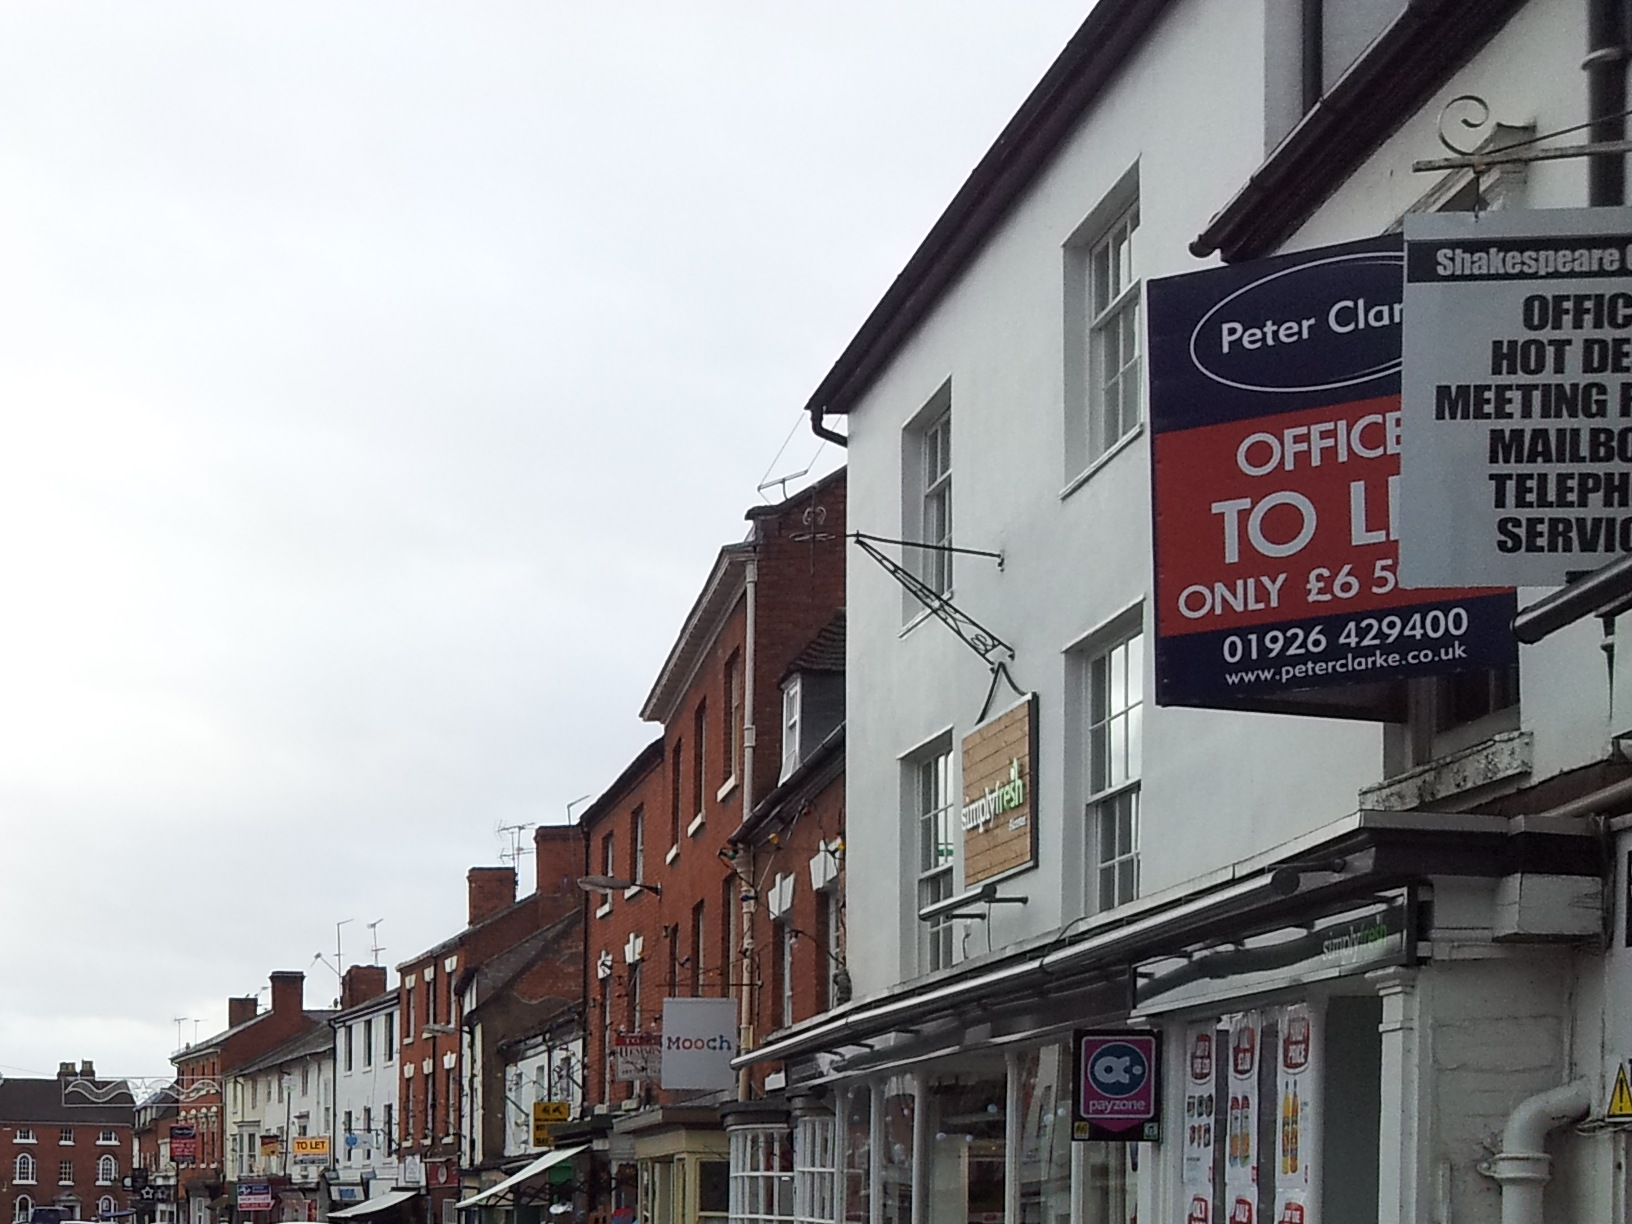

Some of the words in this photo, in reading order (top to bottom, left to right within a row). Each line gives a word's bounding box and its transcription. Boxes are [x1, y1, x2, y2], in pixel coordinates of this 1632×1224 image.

[1436, 248, 1619, 276] Shakespeare
[1221, 317, 1316, 354] Peter
[1491, 338, 1572, 376] HOT
[1435, 382, 1608, 421] MEETING
[1488, 472, 1632, 509] TELEPH
[1211, 490, 1317, 564] TO
[1178, 573, 1288, 619] ONLY
[1223, 626, 1327, 664] 01926
[1339, 607, 1468, 648] 429400
[1225, 641, 1467, 686] www.peterclarke.co.uk
[667, 1034, 732, 1050] Mooch
[1089, 1099, 1146, 1114] payzone
[296, 1141, 308, 1150] TO
[310, 1141, 326, 1150] LET
